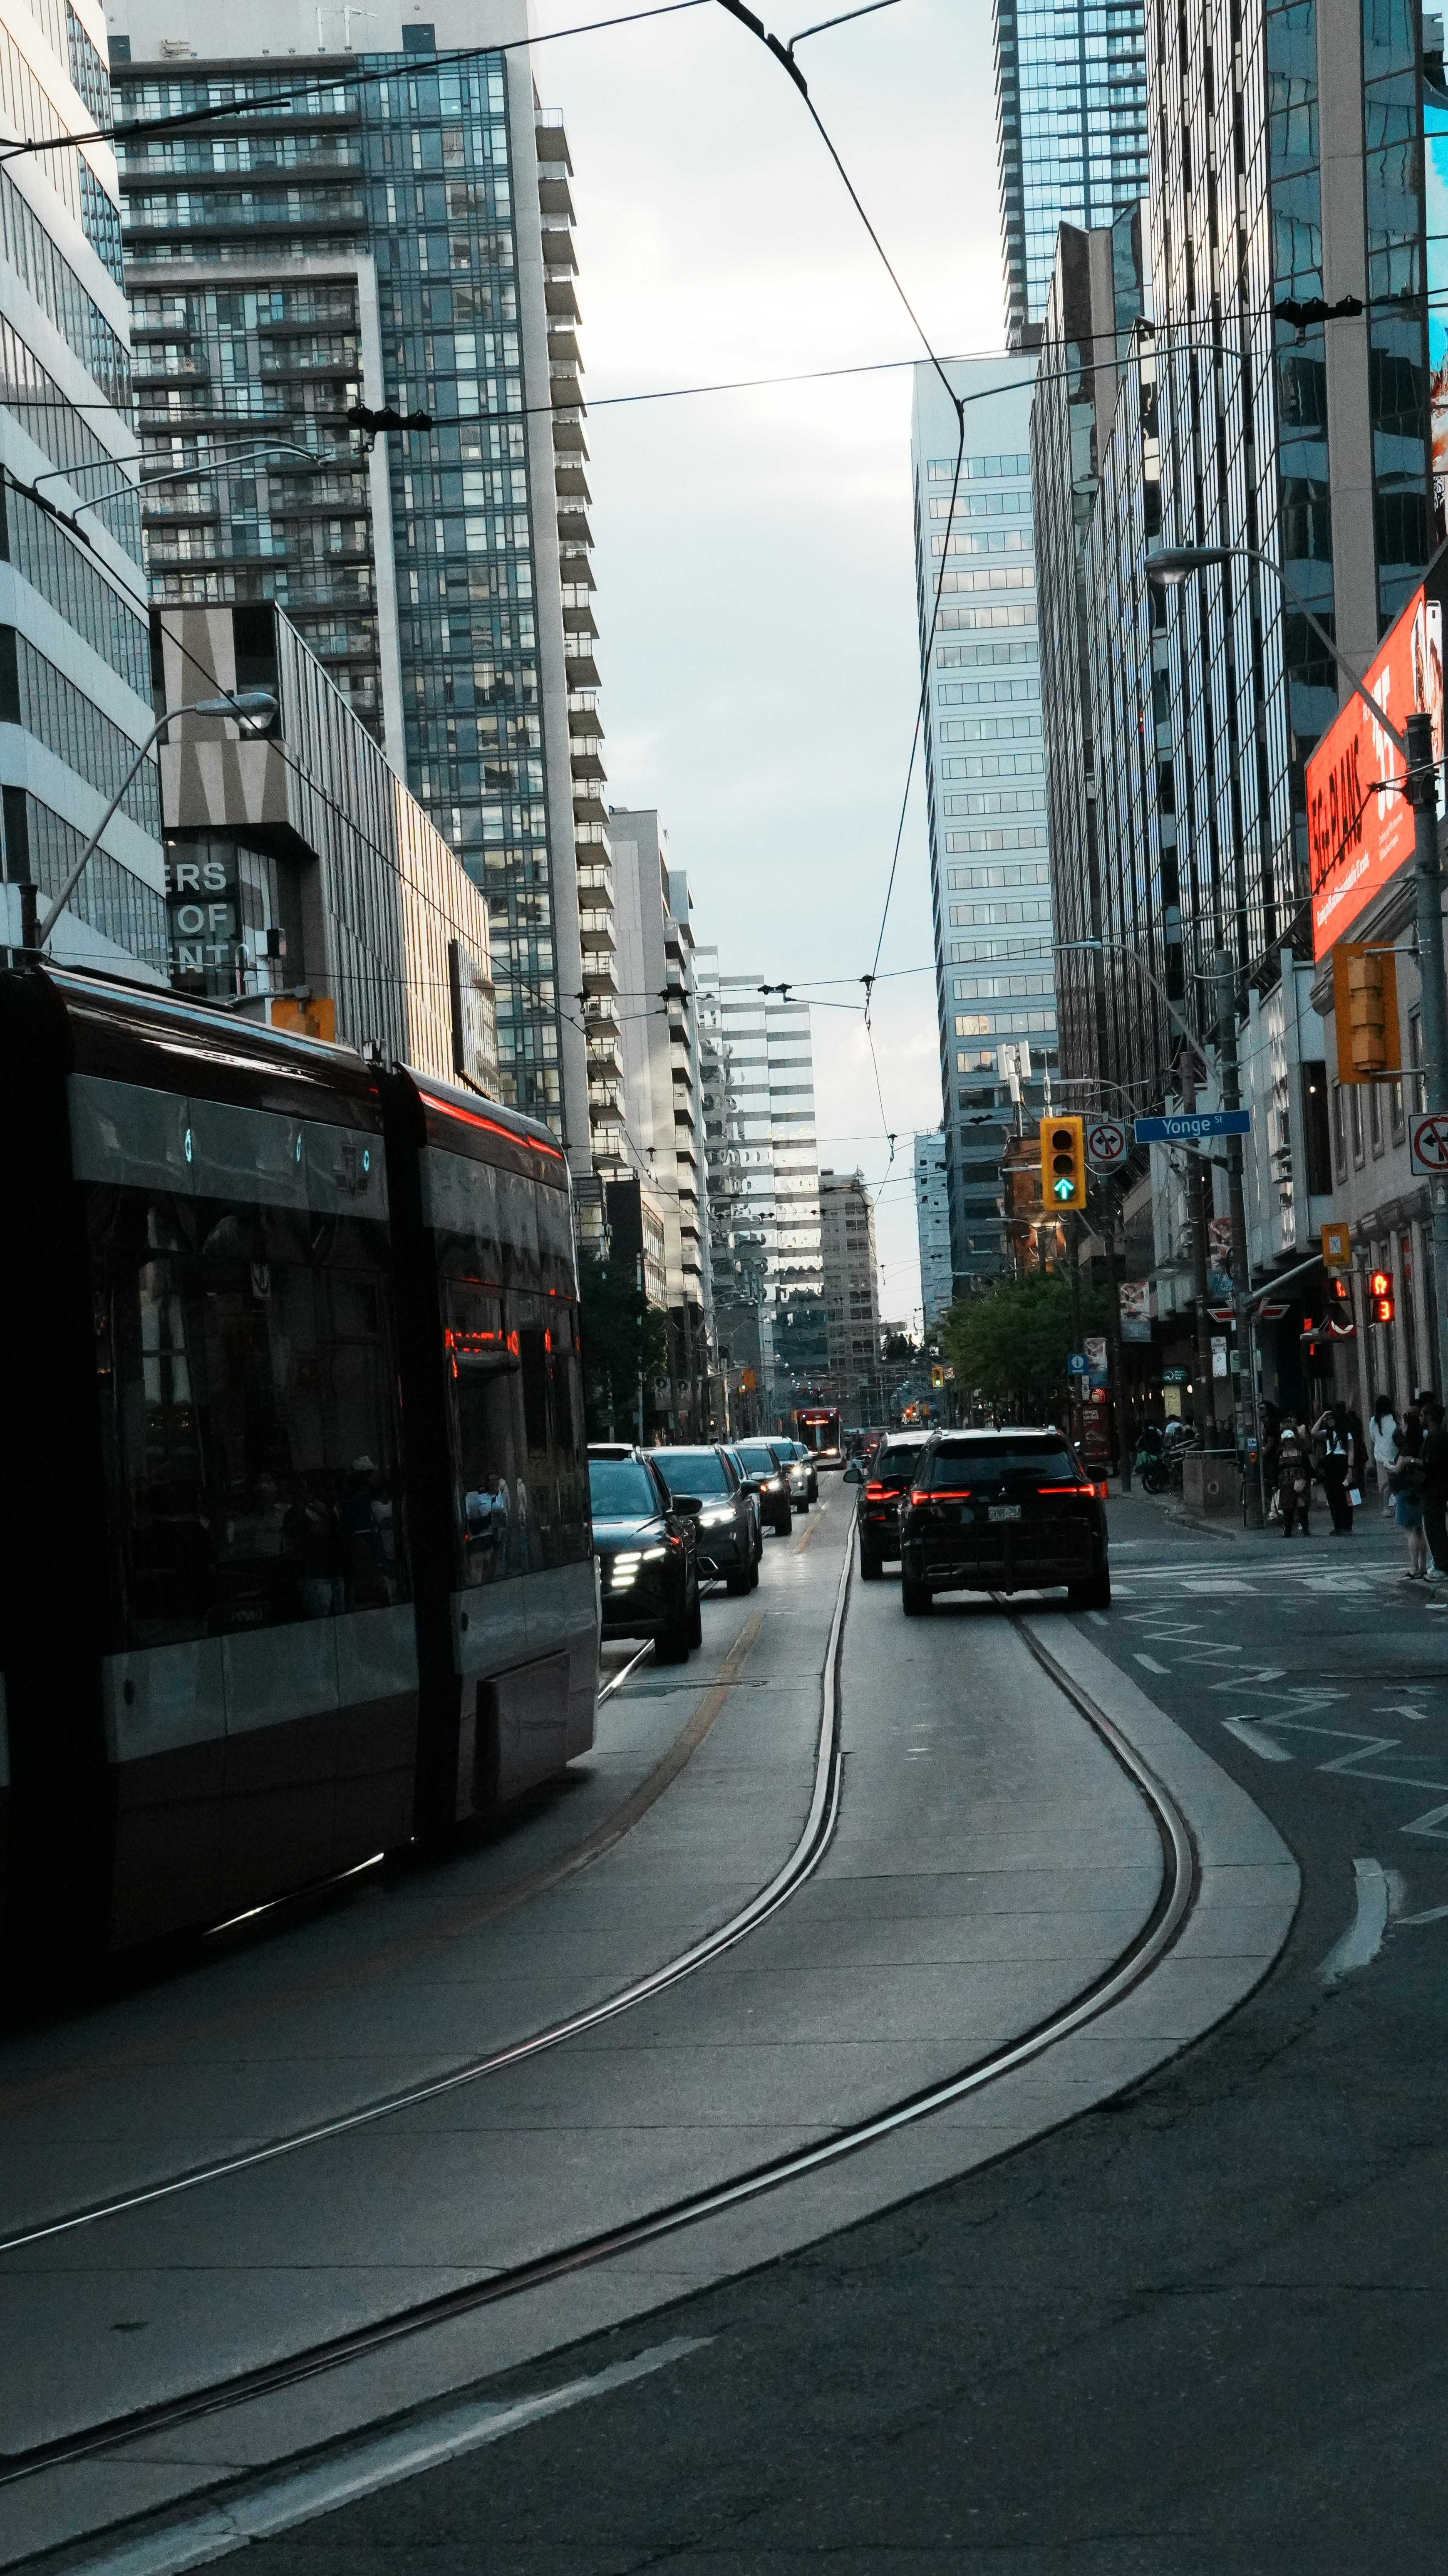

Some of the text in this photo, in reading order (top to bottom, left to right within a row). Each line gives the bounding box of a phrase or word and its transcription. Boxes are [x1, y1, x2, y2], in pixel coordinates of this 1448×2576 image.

[1329, 734, 1362, 873] PLANS
[178, 904, 227, 933] OF
[168, 944, 228, 975] NT
[1162, 1119, 1210, 1136] Yonge
[1381, 1301, 1390, 1320] 3
